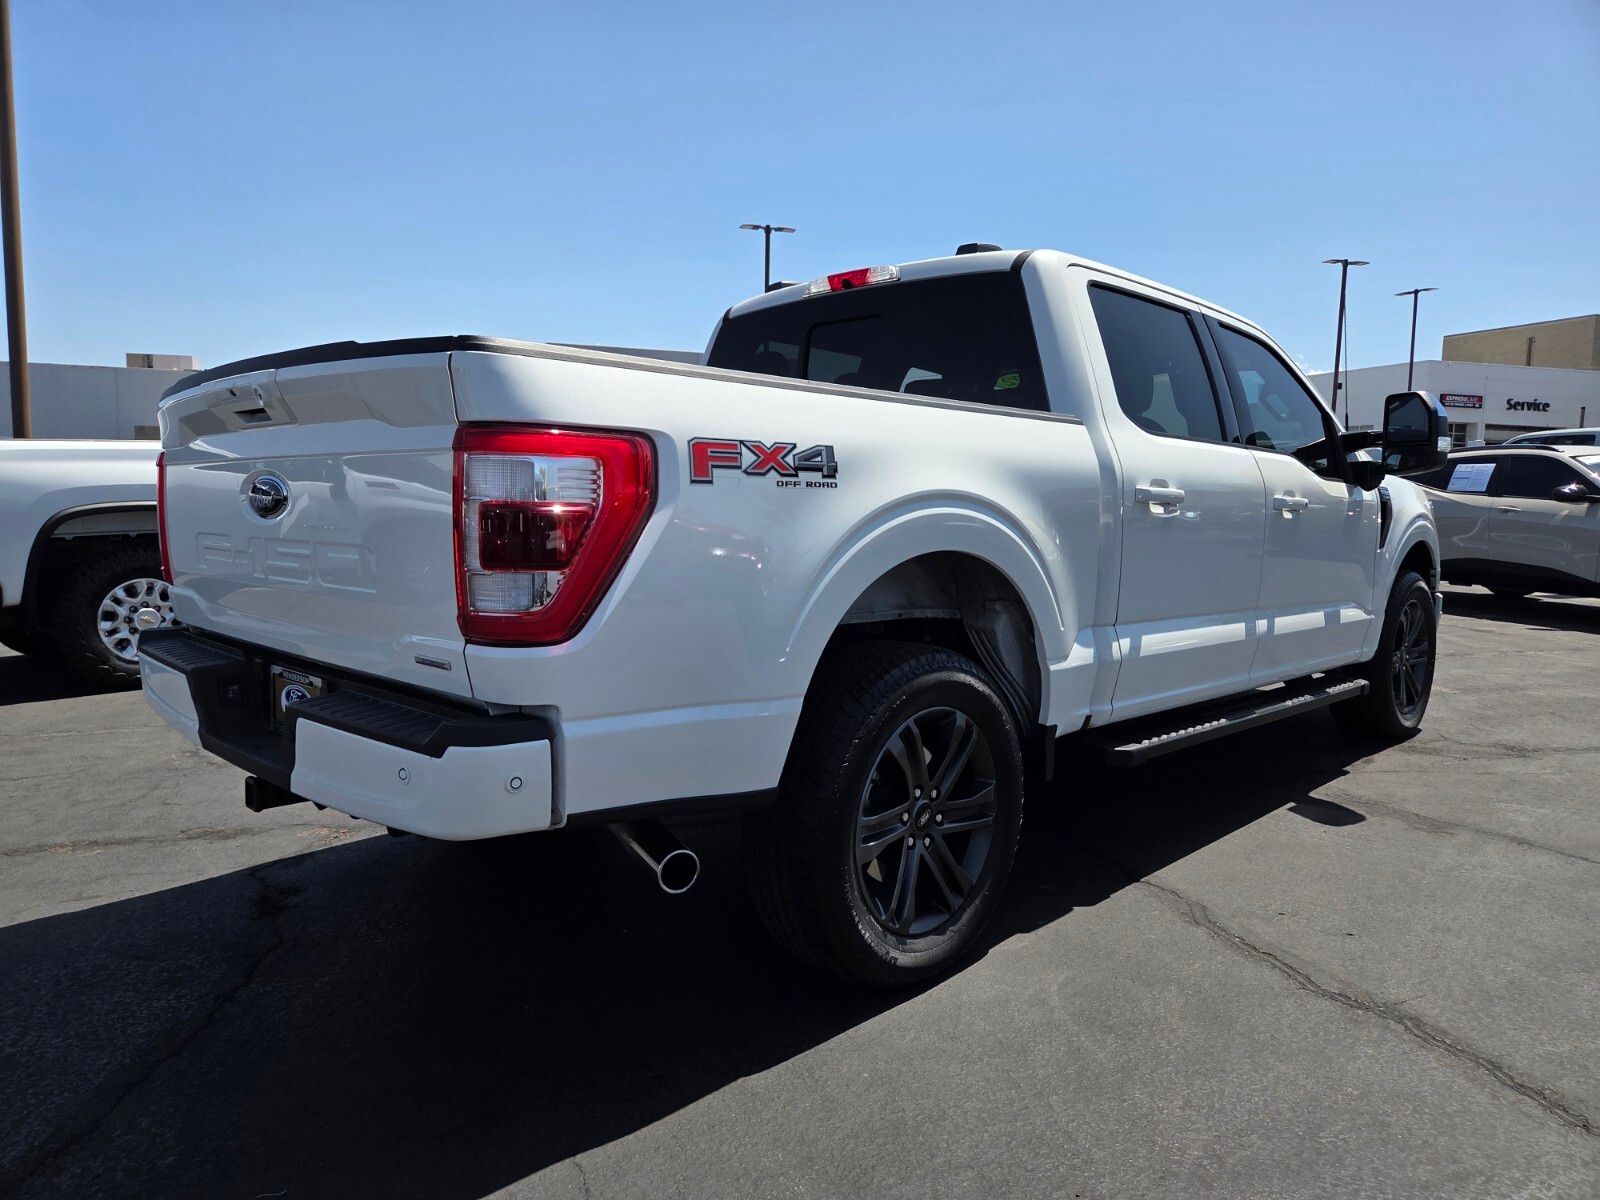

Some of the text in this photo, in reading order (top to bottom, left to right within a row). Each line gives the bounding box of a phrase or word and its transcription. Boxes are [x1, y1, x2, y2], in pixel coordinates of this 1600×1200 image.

[1506, 398, 1550, 412] Service
[687, 436, 838, 484] FX4
[776, 480, 838, 489] OFF ROAD
